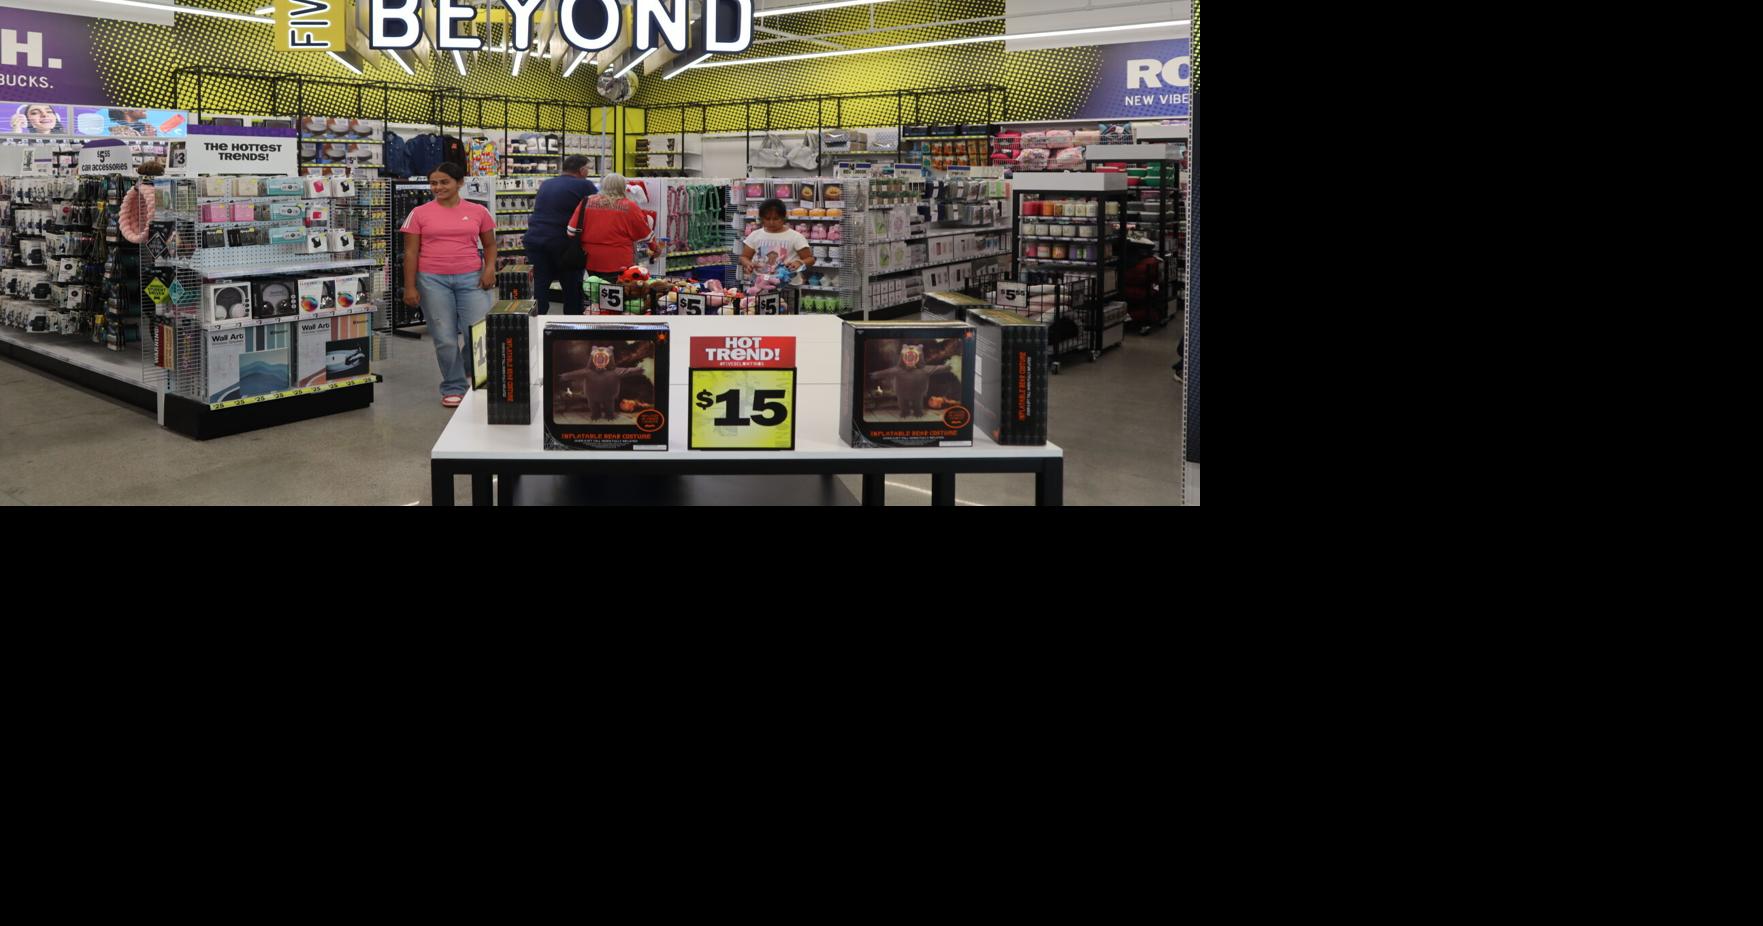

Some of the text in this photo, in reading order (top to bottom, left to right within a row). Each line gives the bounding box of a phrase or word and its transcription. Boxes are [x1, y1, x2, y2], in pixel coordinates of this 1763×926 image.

[370, 0, 753, 52] BEYOND
[1125, 95, 1154, 106] NEW
[601, 288, 621, 307] $5
[760, 297, 777, 315] $5
[680, 298, 702, 315] $5
[212, 334, 228, 342] Wall
[725, 337, 762, 348] HOT
[696, 389, 788, 427] $15
